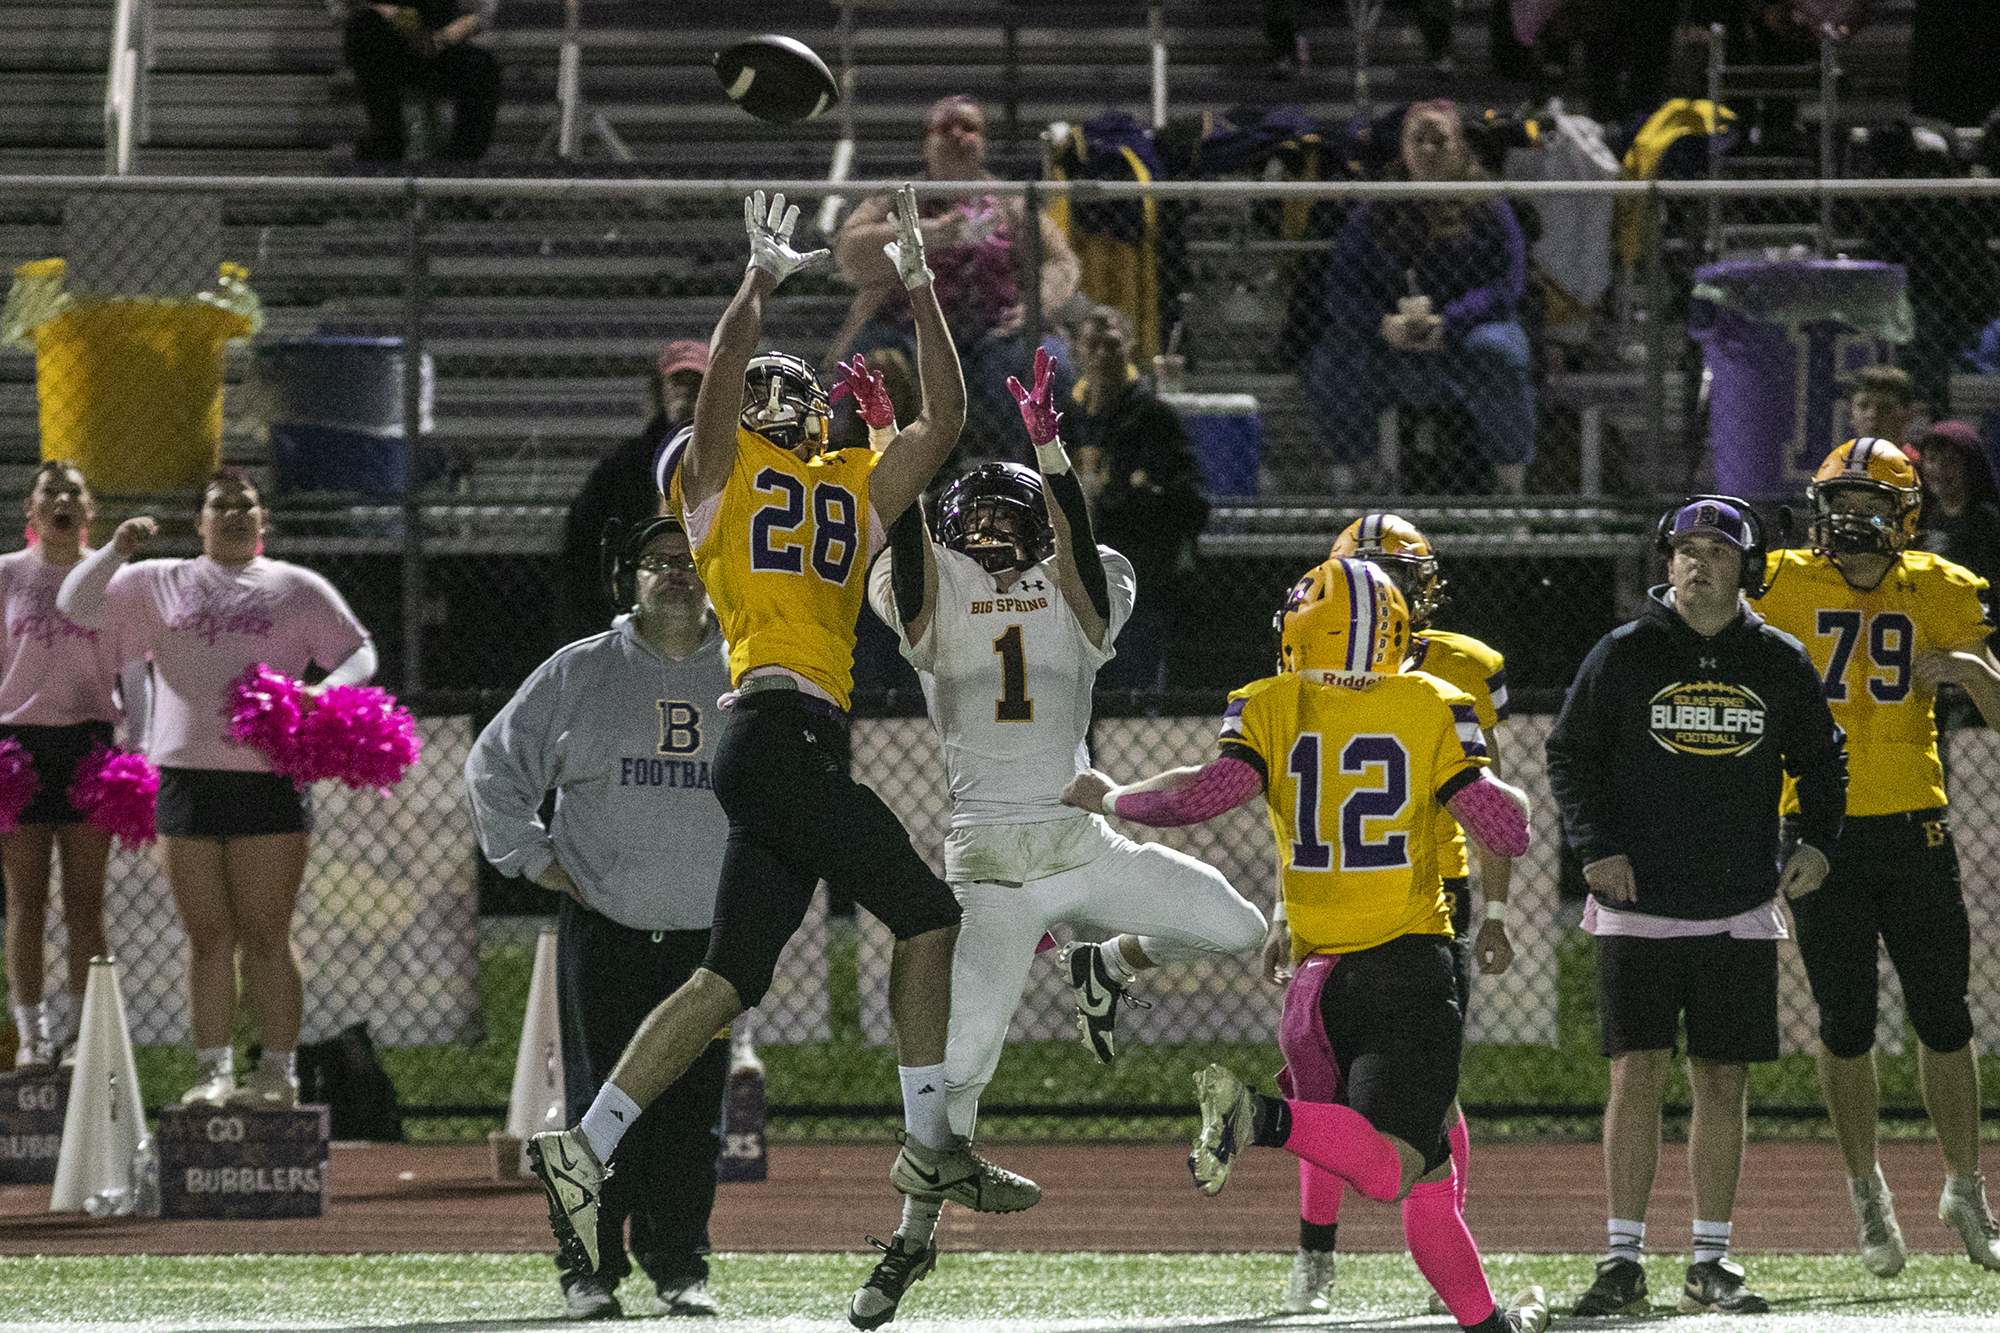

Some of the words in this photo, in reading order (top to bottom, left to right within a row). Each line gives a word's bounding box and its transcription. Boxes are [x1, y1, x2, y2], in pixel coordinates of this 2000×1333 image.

[749, 465, 860, 588] 28
[971, 601, 994, 615] BIG
[996, 597, 1049, 613] SPRING
[1815, 608, 1917, 705] 79
[992, 624, 1034, 723] 1
[656, 699, 703, 757] B
[1650, 704, 1765, 735] BUBBLERS
[1675, 732, 1740, 745] FOOTBALL
[1287, 731, 1412, 872] 12
[17, 1085, 58, 1111] GO
[206, 1115, 245, 1142] GO
[184, 1167, 321, 1194] BUBBLERS
